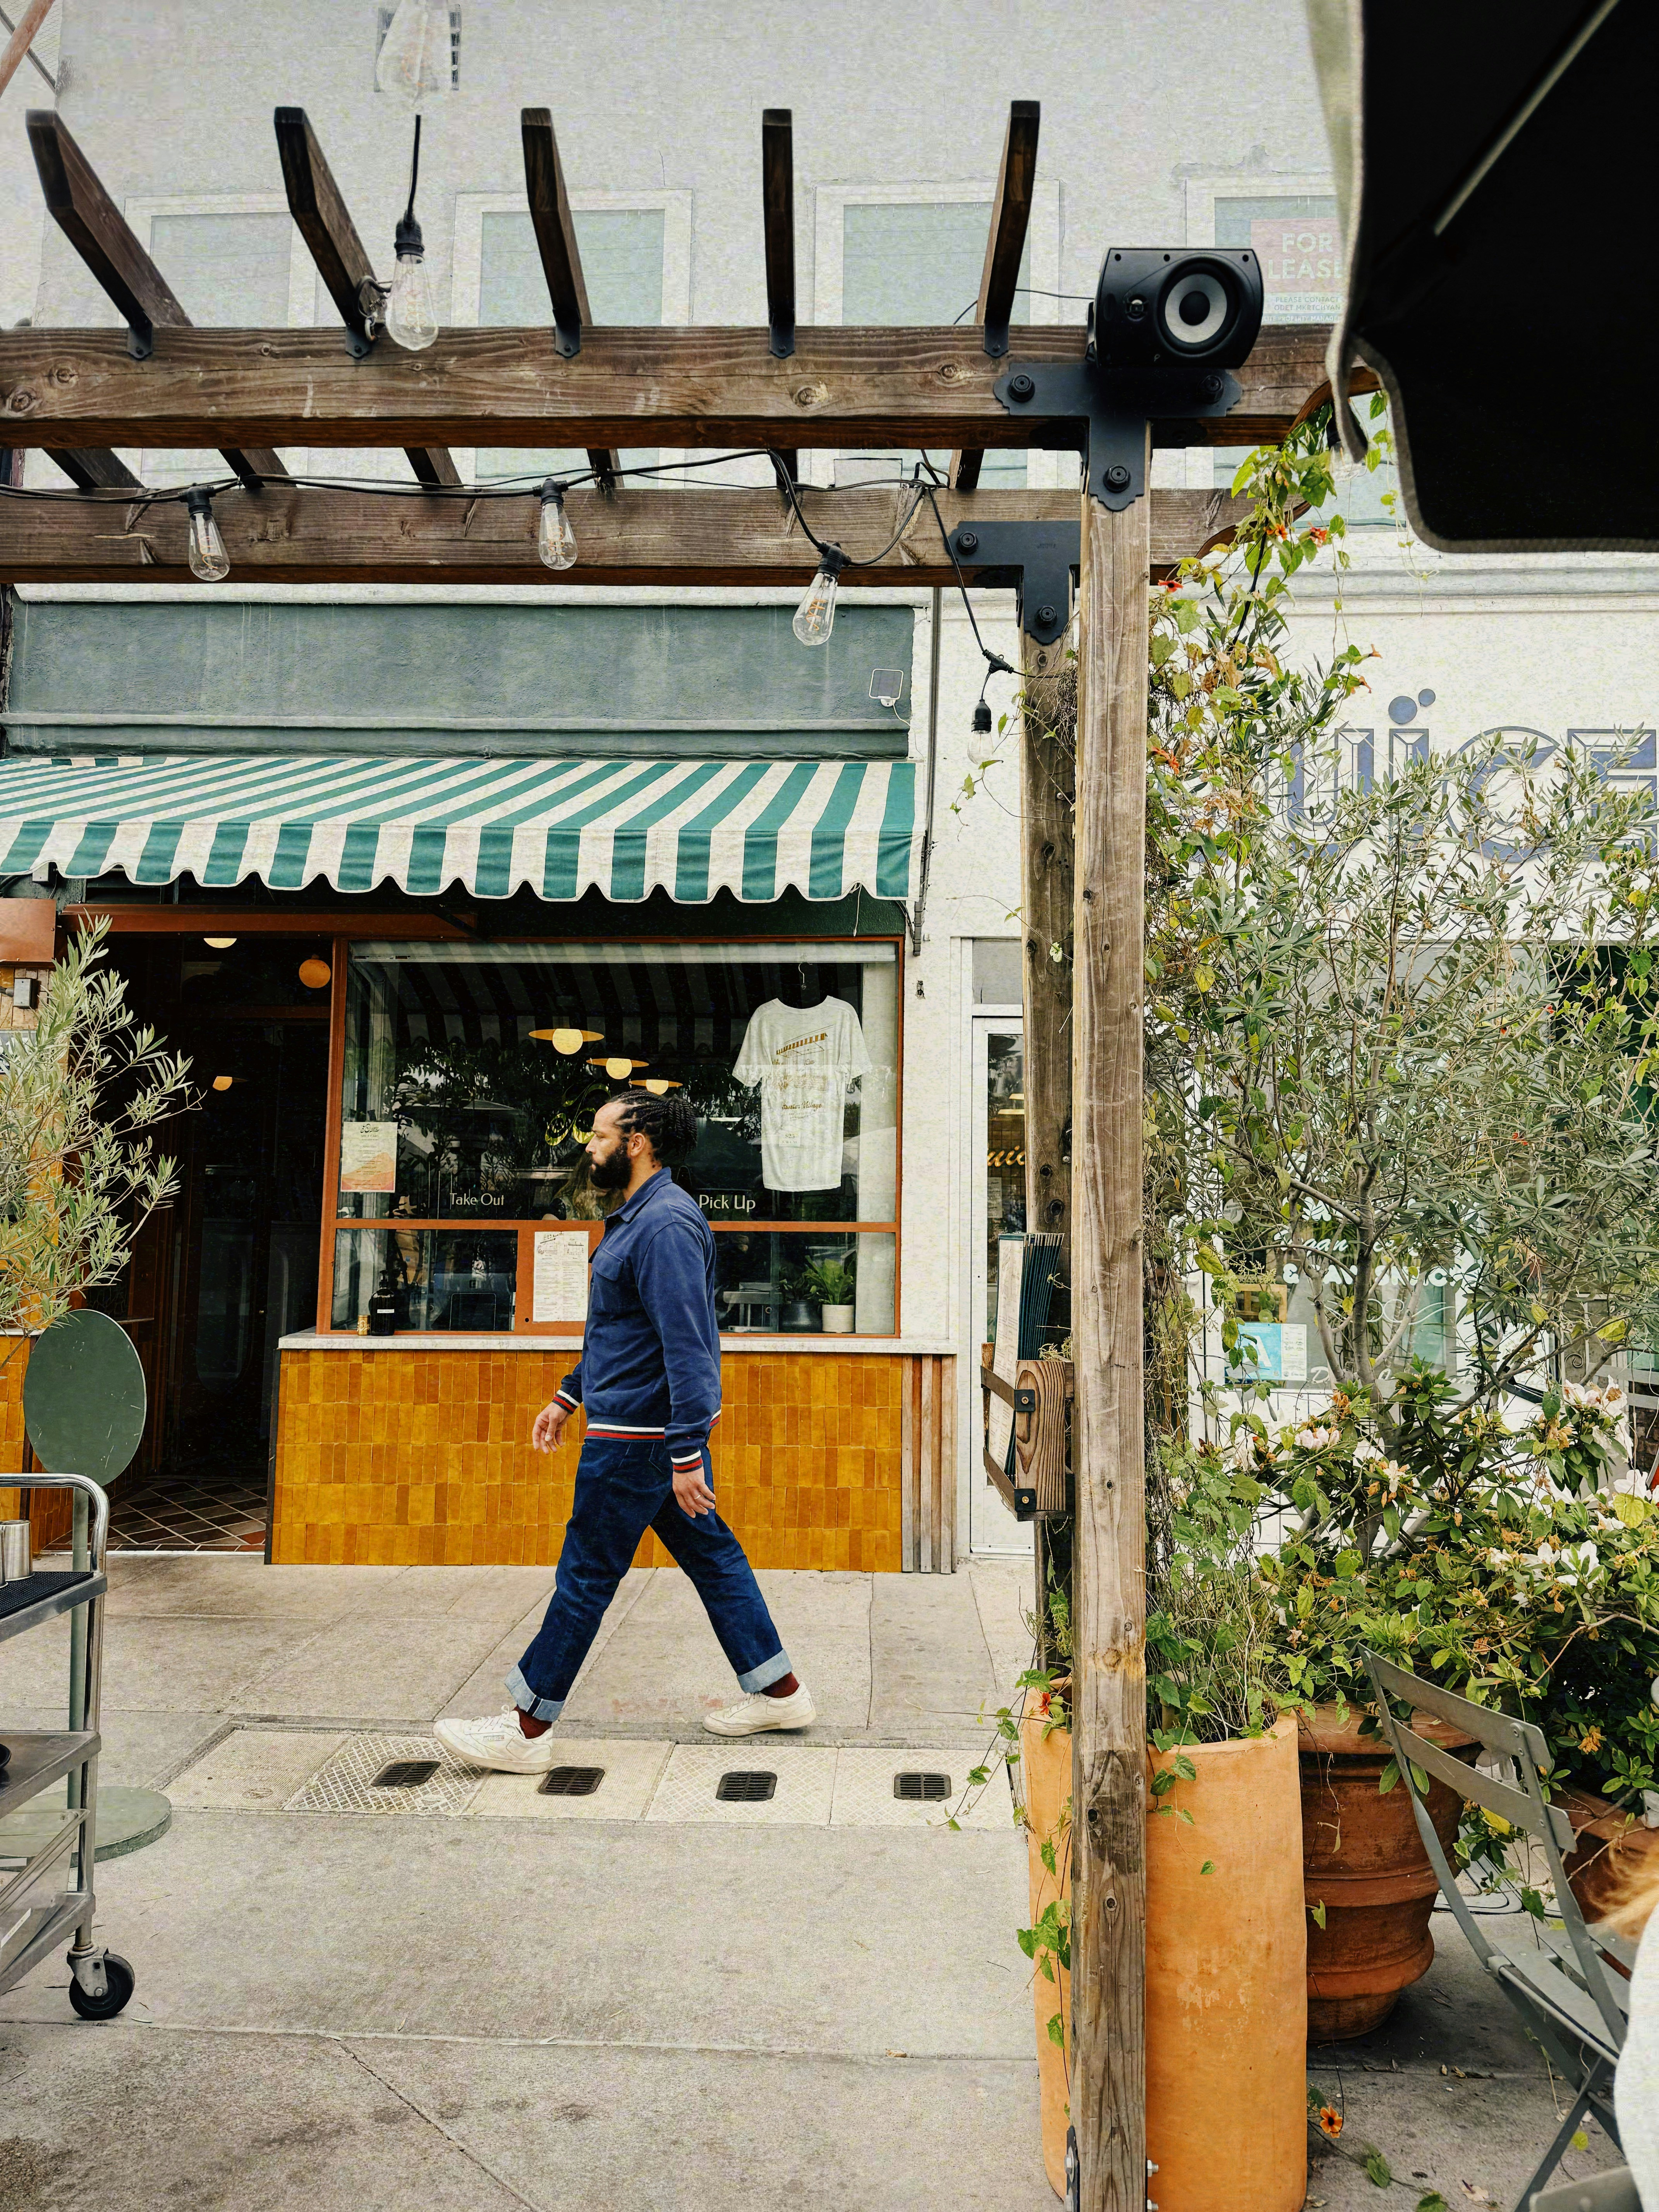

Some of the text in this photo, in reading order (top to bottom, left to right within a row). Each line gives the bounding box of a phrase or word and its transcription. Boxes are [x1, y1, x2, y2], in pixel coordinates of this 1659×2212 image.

[1282, 232, 1334, 252] FOR
[1268, 258, 1345, 279] LEASE
[450, 1193, 504, 1206] Take Out
[699, 1194, 756, 1212] Pick Up
[1283, 1263, 1300, 1284] &
